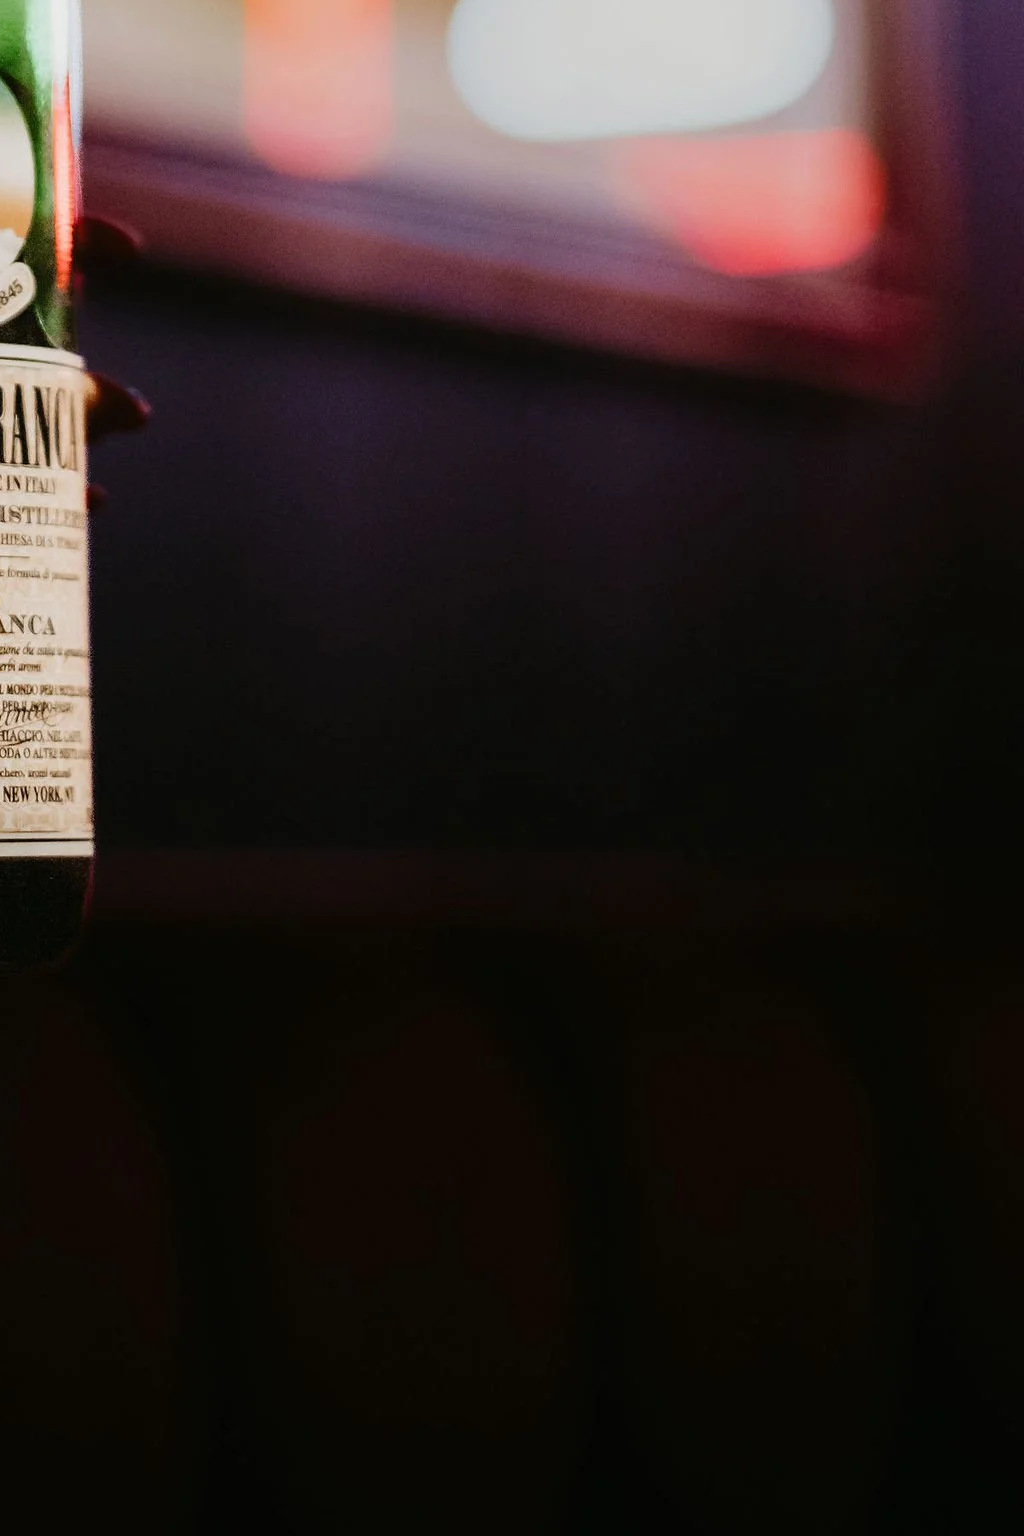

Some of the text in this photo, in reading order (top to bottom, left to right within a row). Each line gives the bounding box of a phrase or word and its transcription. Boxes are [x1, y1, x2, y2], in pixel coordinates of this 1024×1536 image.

[7, 475, 22, 491] IN
[26, 477, 56, 494] ITALY
[6, 683, 38, 696] MONDO
[3, 785, 32, 803] NEW
